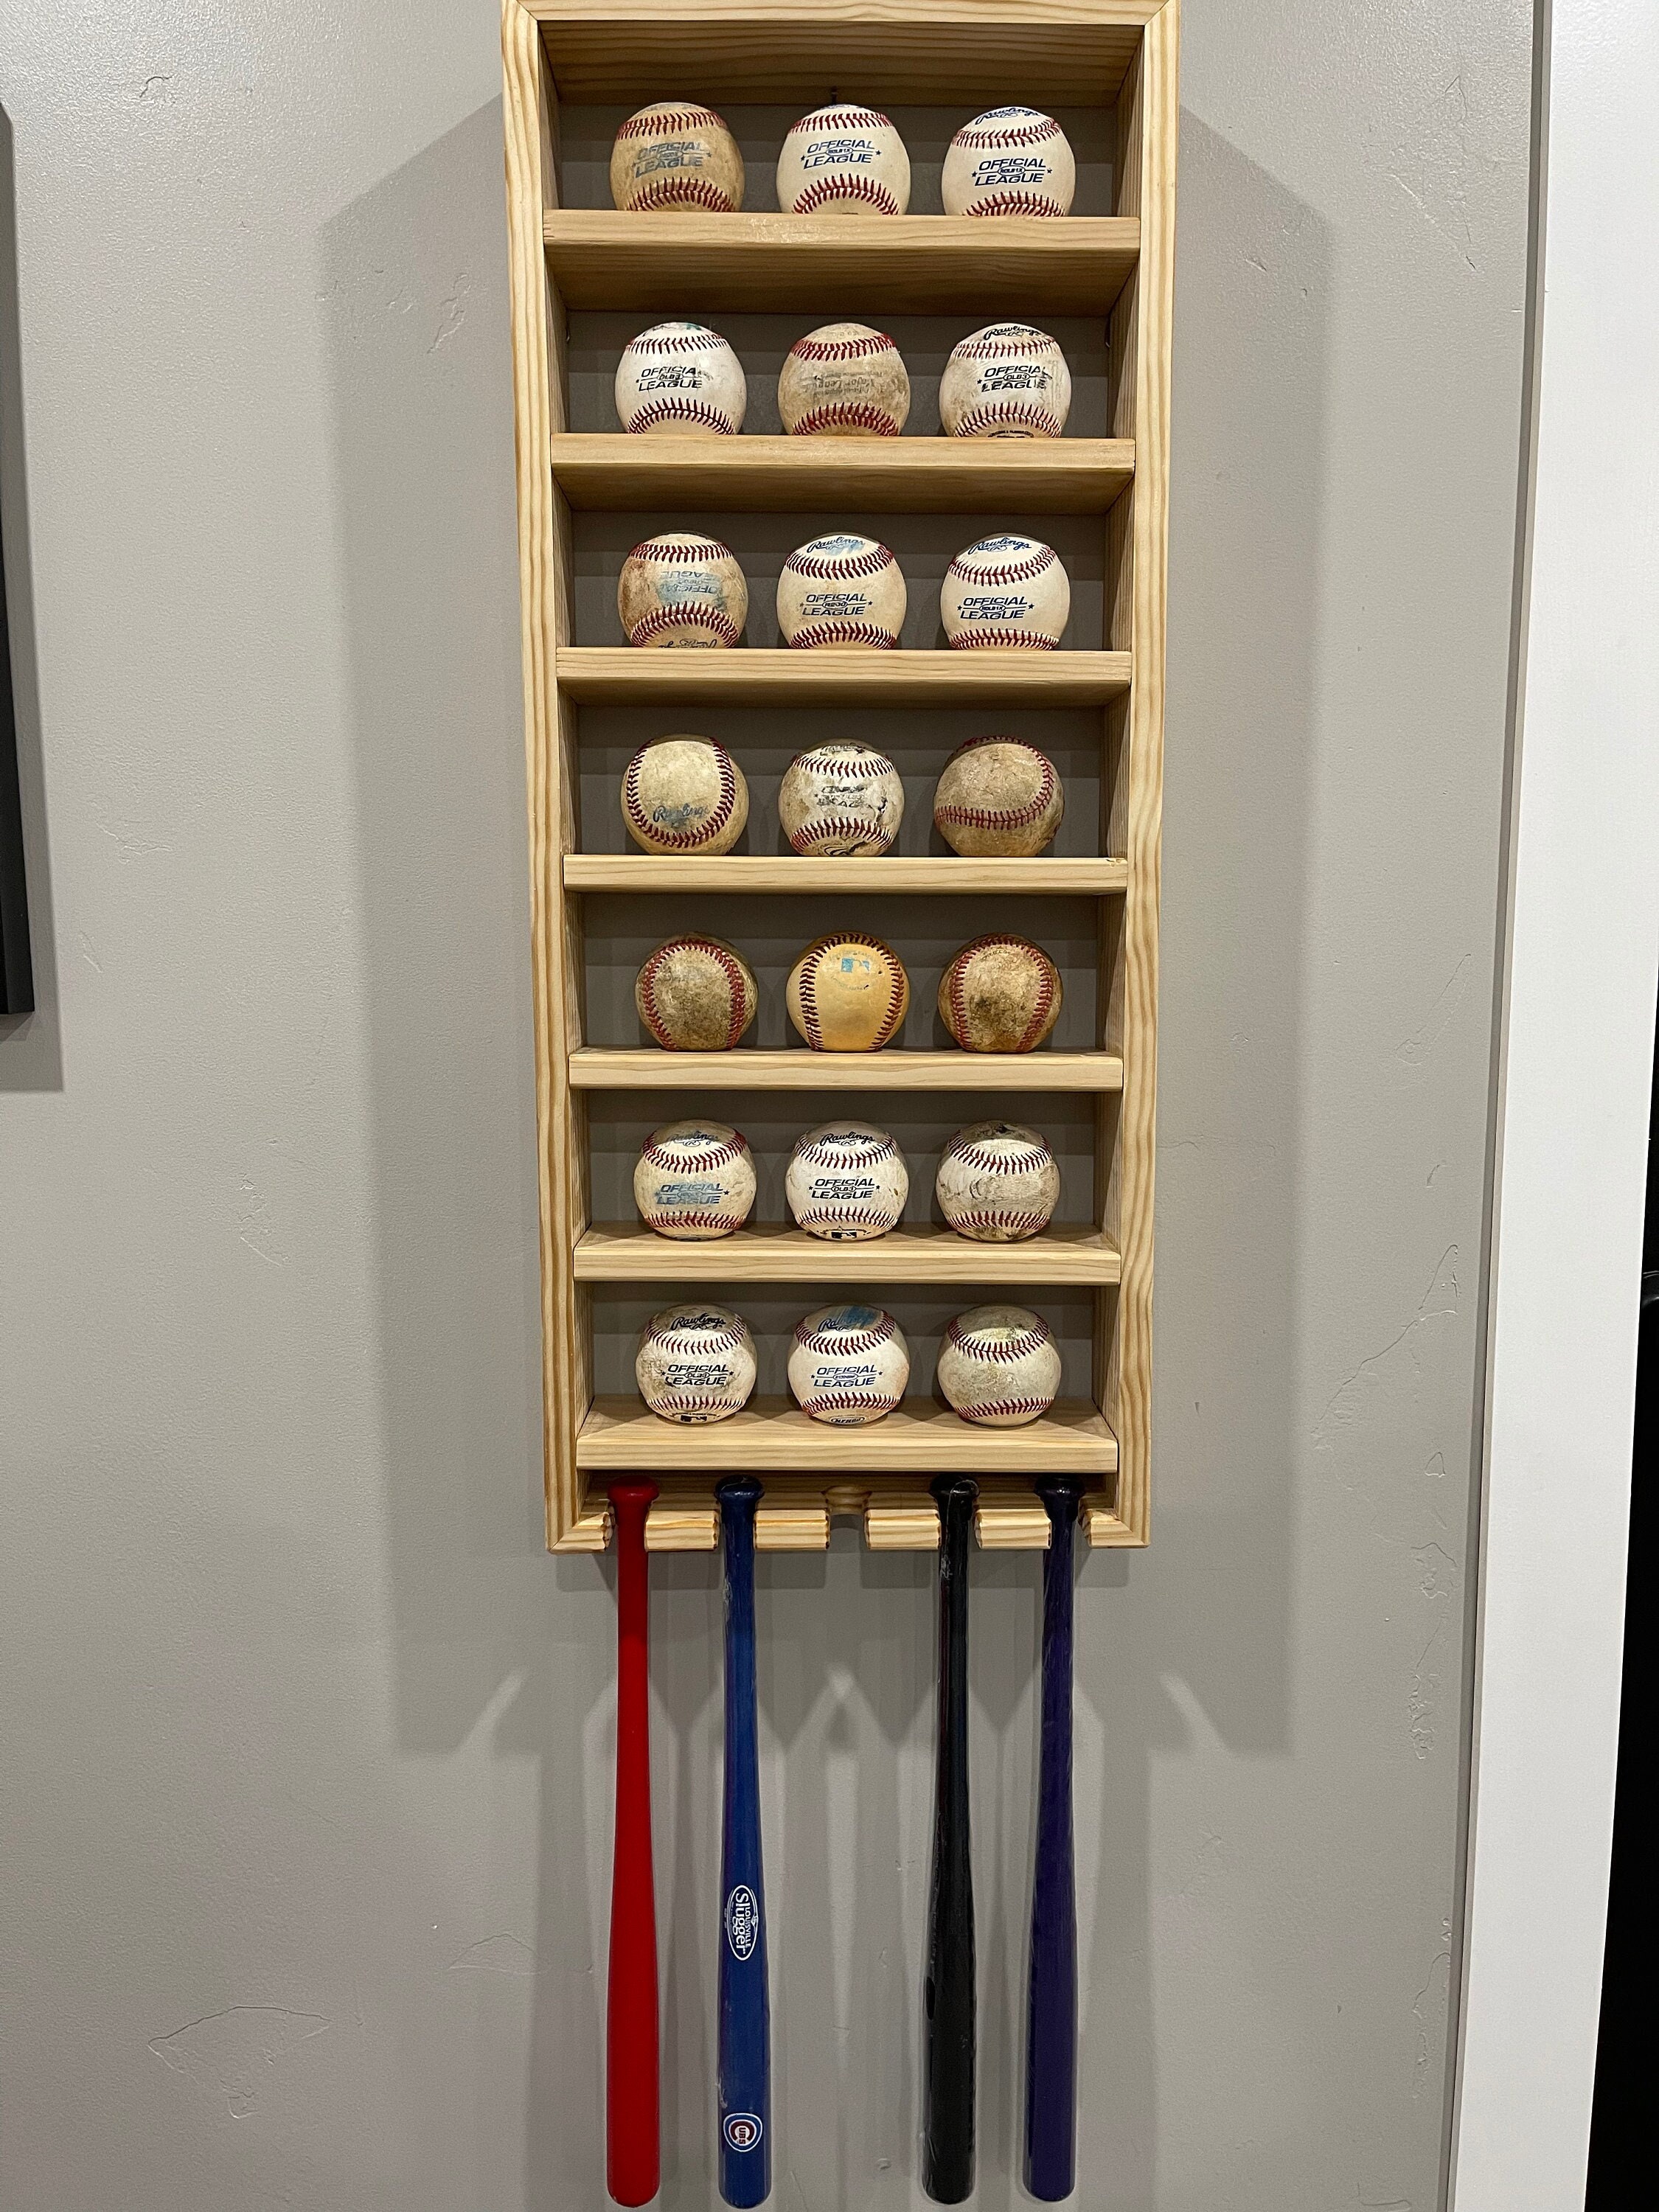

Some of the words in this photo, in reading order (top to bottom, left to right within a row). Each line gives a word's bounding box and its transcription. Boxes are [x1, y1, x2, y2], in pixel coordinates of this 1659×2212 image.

[638, 141, 706, 160] OFFICIAL
[807, 139, 875, 154] OFFICIAL
[635, 156, 703, 178] LEAGUE
[804, 153, 873, 170] LEAGUE
[978, 158, 1046, 171] OFFICIAL
[974, 173, 1045, 186] LEAGUE
[641, 366, 698, 378] OFFICIA
[638, 380, 703, 392] LEAGUE
[967, 537, 1032, 555] Rawlings
[805, 594, 867, 602] OFFICIAL
[963, 596, 1028, 607] OFFICIAL
[801, 606, 866, 616] LEAGUE
[960, 609, 1026, 620] LEAGUE
[819, 1131, 875, 1147] Rawlings
[660, 1183, 723, 1194] OFFICIAL
[814, 1178, 875, 1187] OFFICIAL
[655, 1194, 722, 1206] LEAGUE
[811, 1190, 873, 1200] LEAGUE
[670, 1312, 726, 1331] Rawlings
[667, 1364, 729, 1373] OFFICIAL
[816, 1364, 877, 1375] OFFICIAL
[665, 1376, 727, 1386] LEAGUE
[813, 1377, 876, 1388] LEAGUE
[732, 1893, 751, 1950] Slugger
